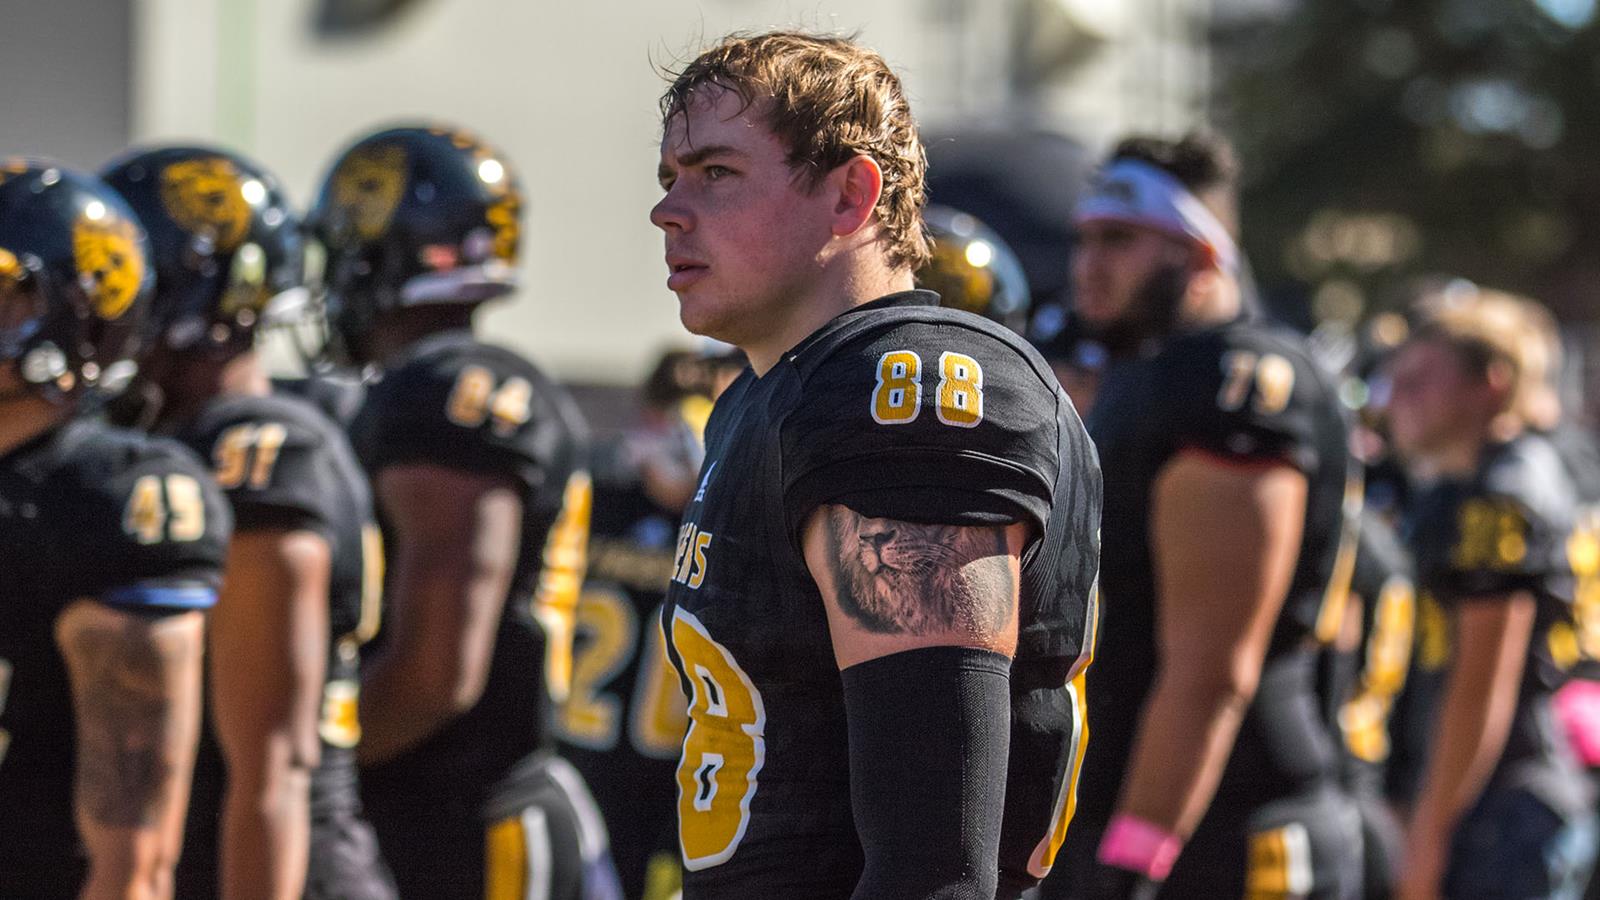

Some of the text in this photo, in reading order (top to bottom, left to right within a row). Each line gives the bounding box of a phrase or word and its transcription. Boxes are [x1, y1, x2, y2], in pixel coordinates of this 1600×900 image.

[871, 350, 984, 428] 88
[671, 522, 713, 589] ERS
[659, 603, 766, 872] 8
